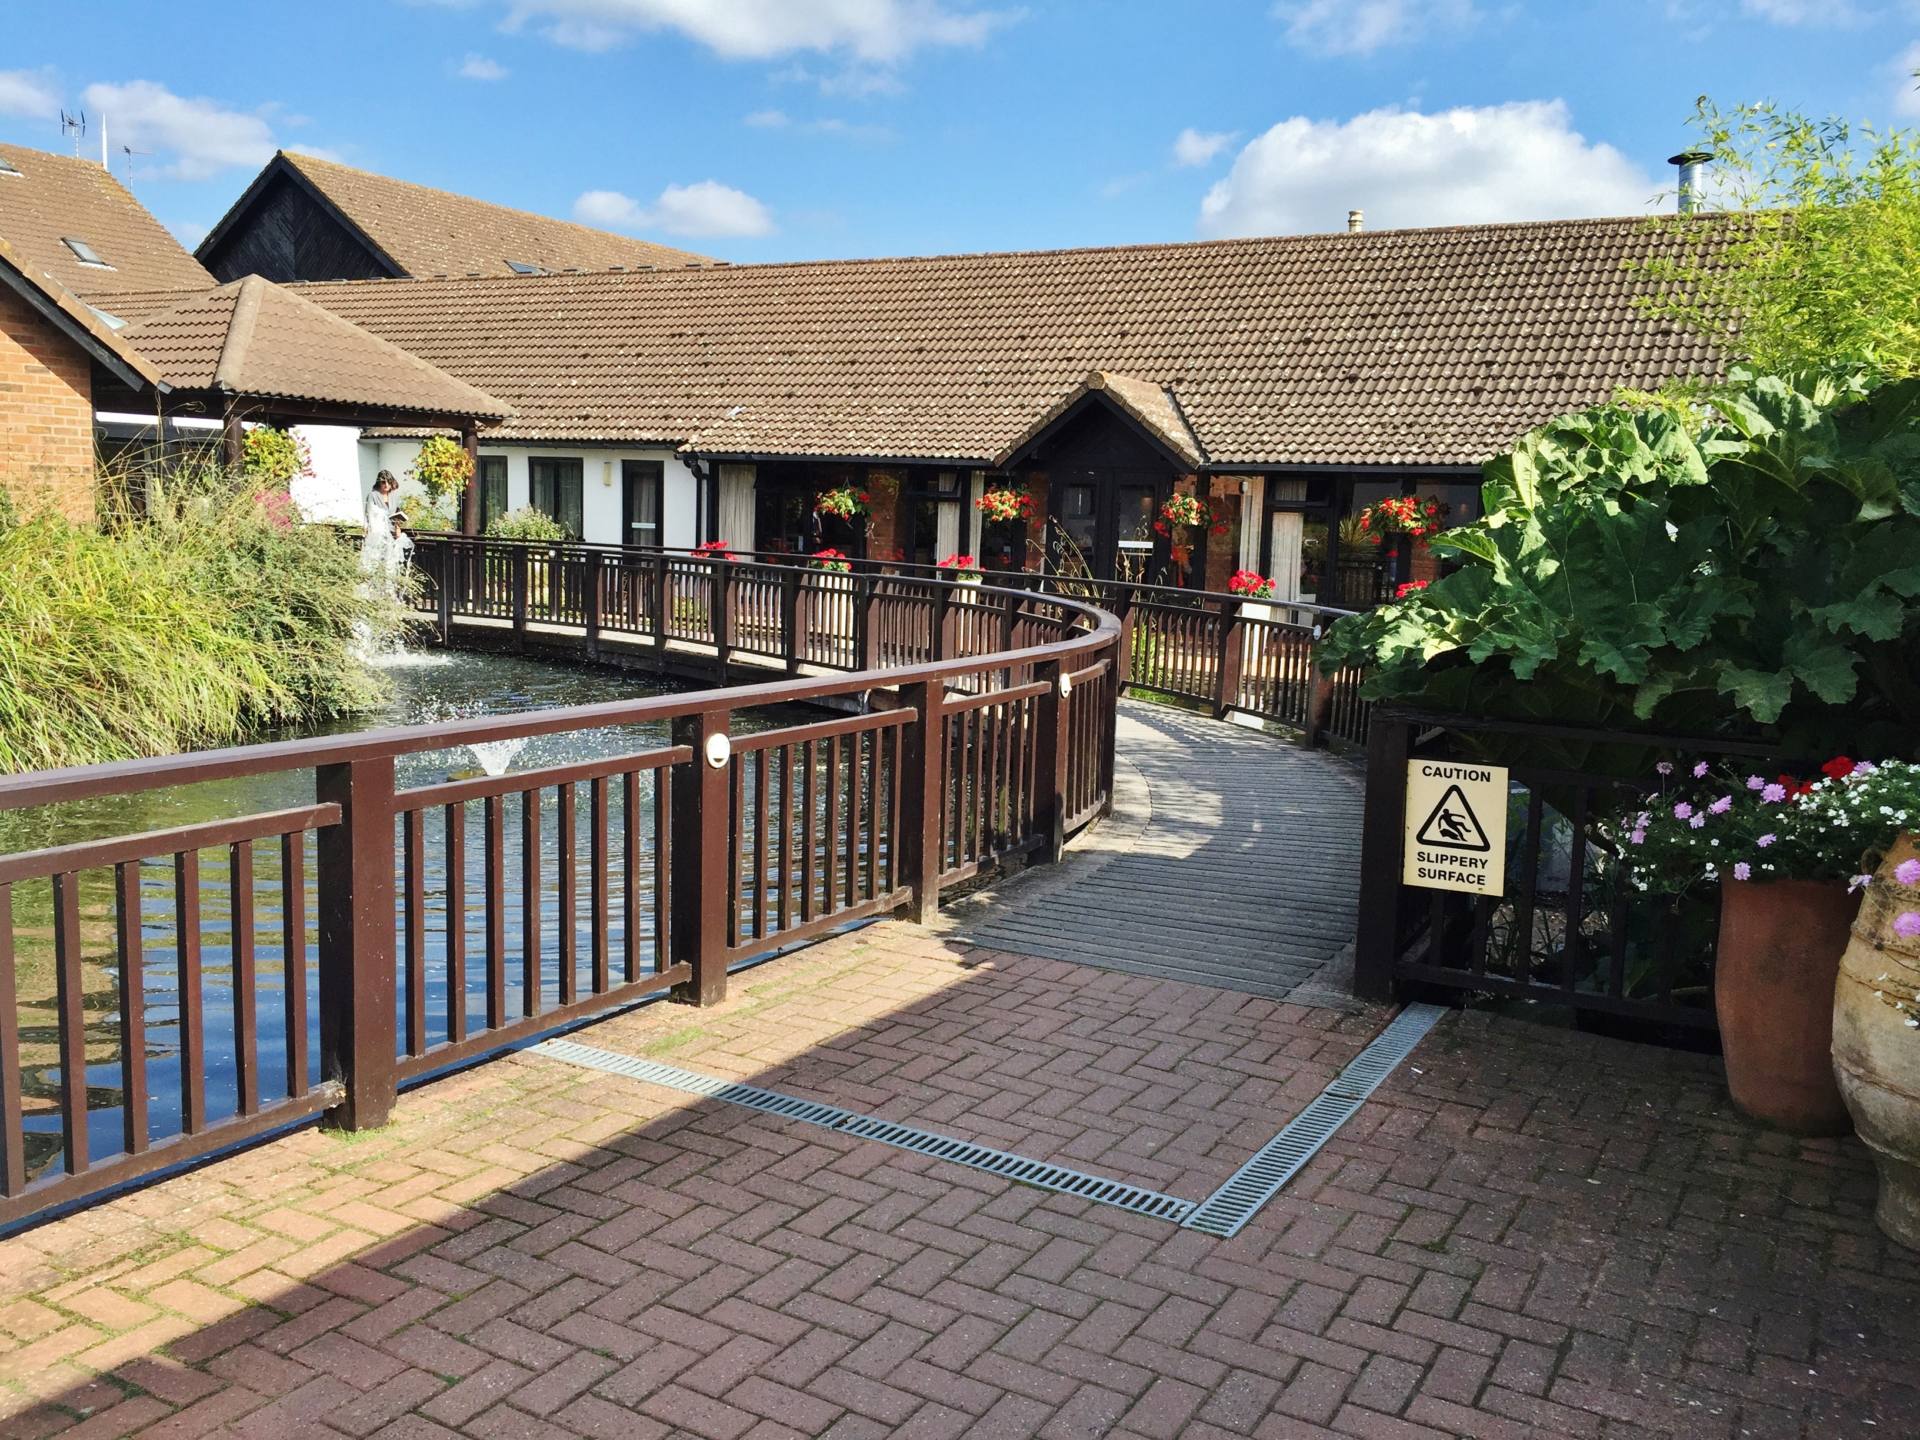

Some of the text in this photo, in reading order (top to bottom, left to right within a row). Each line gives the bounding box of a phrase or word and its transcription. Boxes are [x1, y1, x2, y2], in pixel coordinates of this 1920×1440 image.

[1422, 766, 1491, 783] CAUTION
[1417, 852, 1488, 869] SLIPPERY
[1418, 868, 1486, 885] SURFACE
